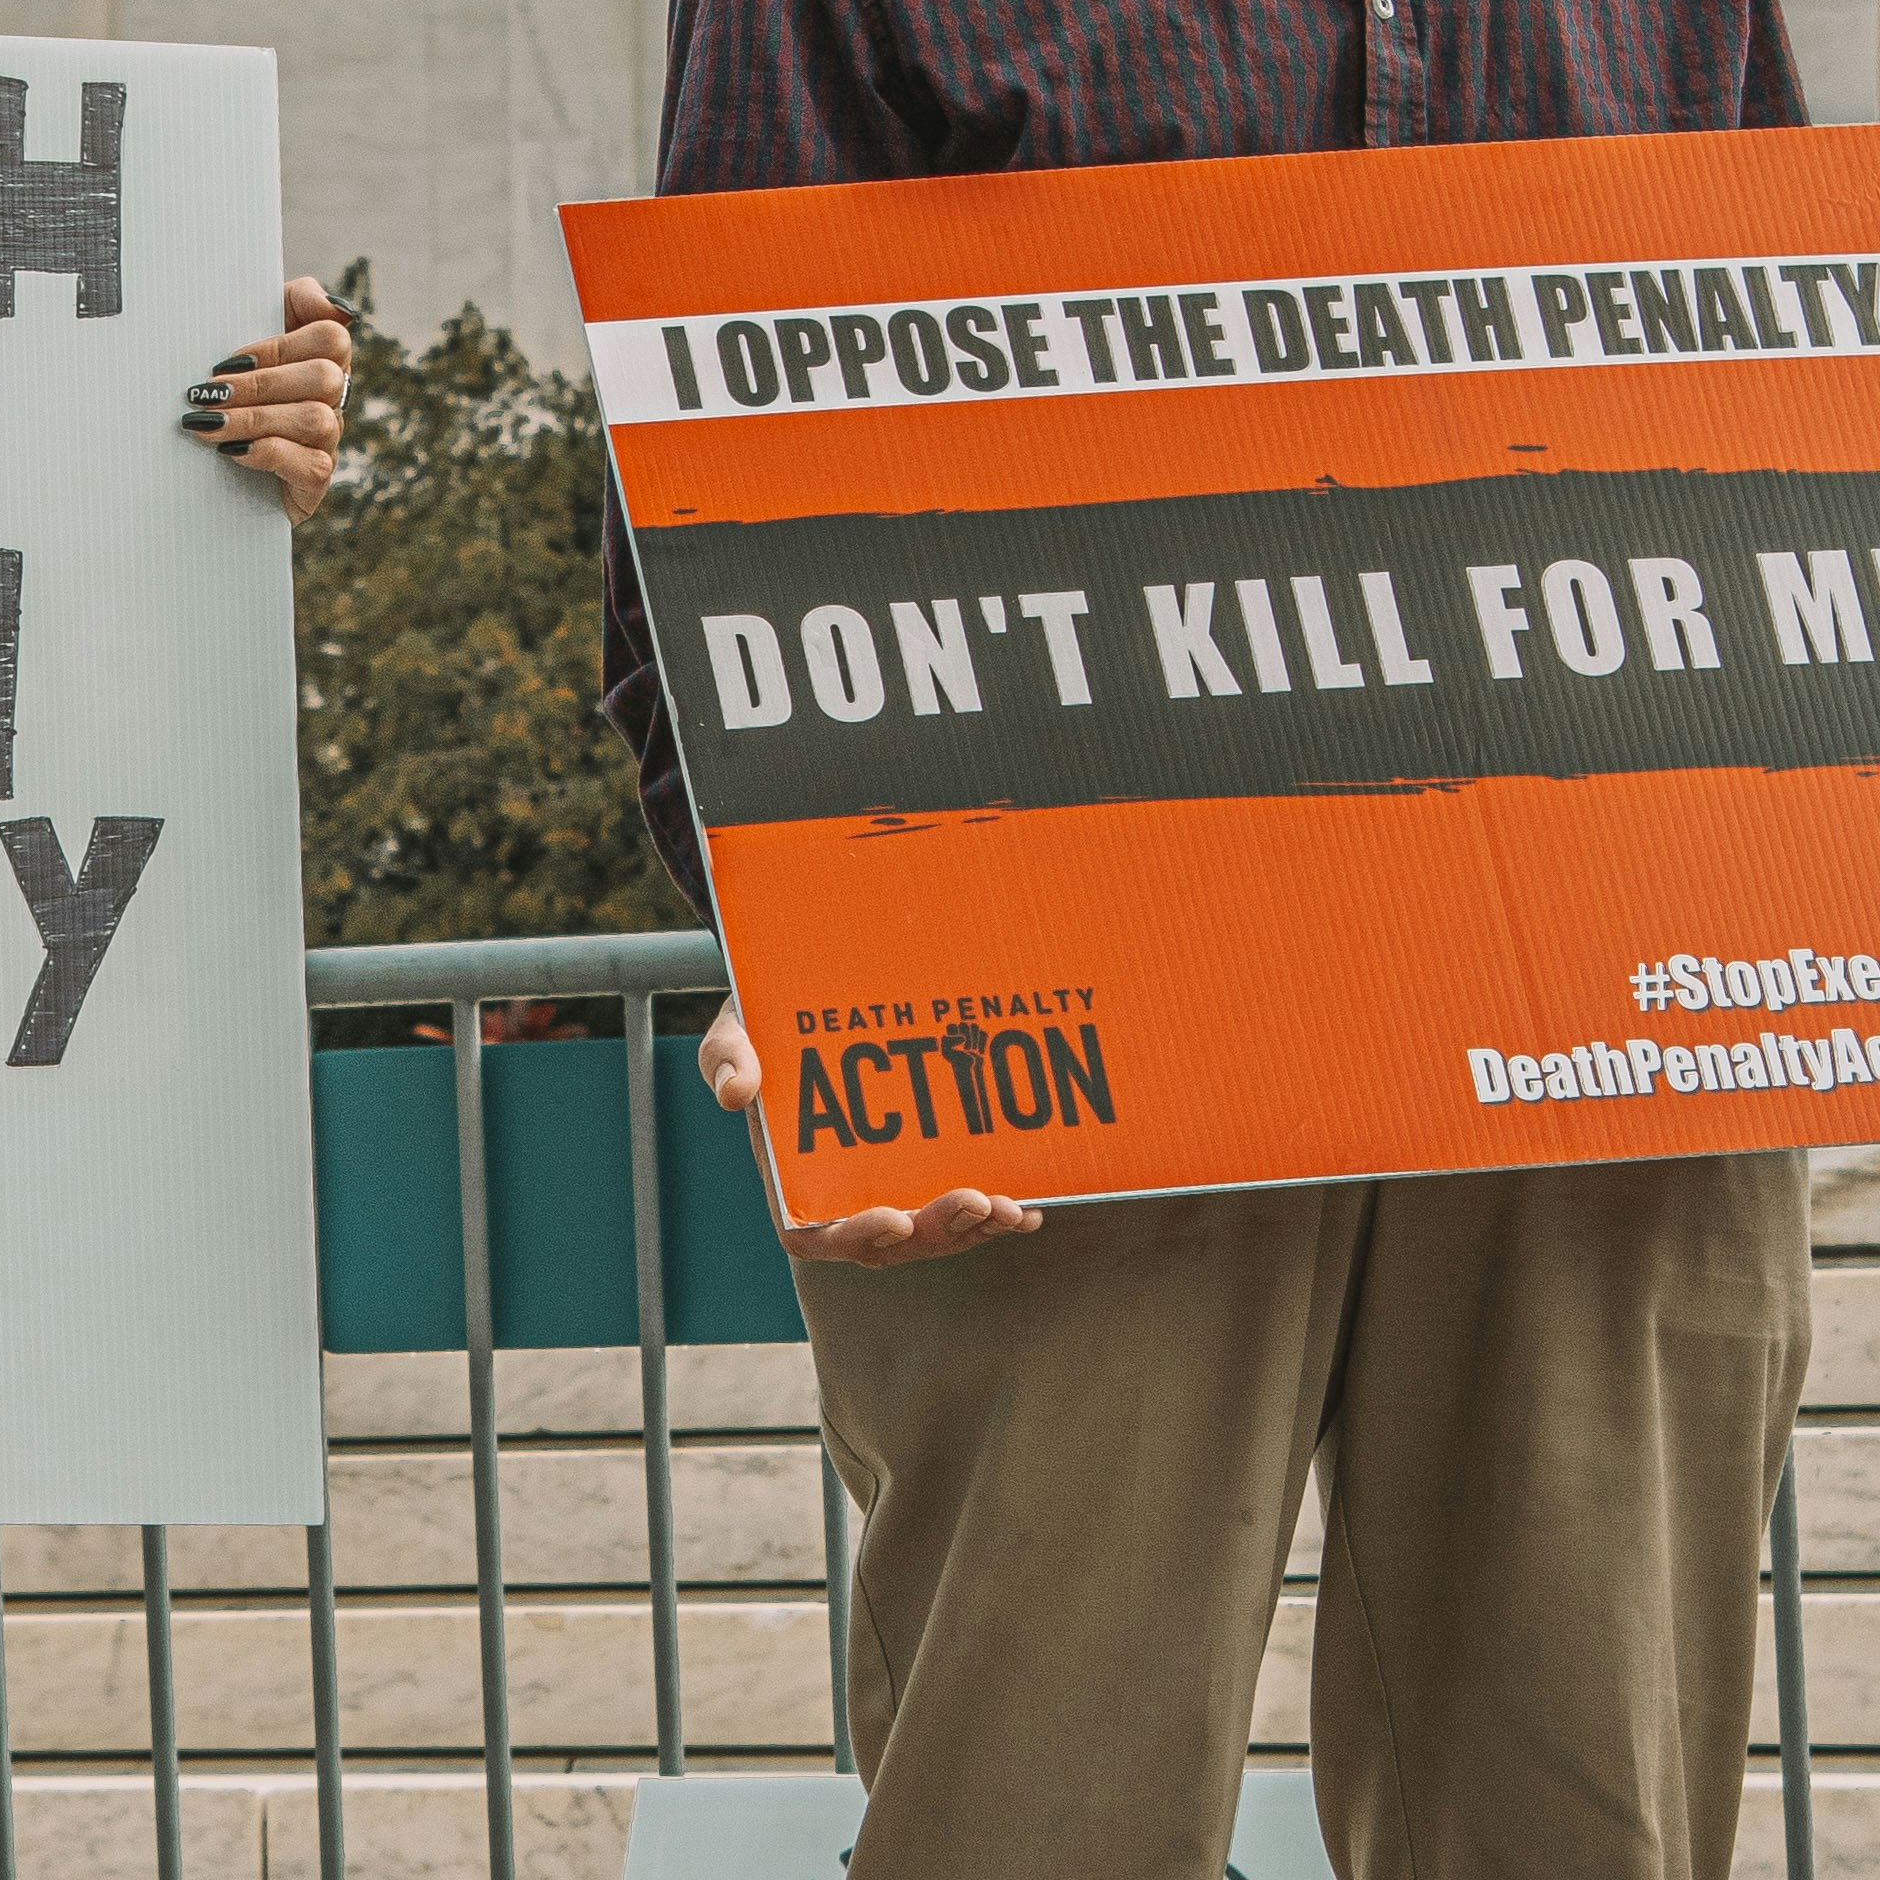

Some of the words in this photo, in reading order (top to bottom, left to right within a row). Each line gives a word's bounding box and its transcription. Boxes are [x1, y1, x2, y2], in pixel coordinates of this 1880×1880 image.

[663, 324, 703, 411] I
[721, 301, 1063, 409] OPPOSE
[1065, 283, 1236, 384] THE
[1240, 275, 1525, 375] DEATH
[1529, 261, 1880, 359] PENALTY
[700, 588, 1094, 731] DON'T
[1141, 569, 1435, 699] KILL
[1465, 557, 1721, 680] FOR
[1755, 547, 1880, 666] M
[796, 1002, 915, 1034] DEATH
[931, 987, 1094, 1022] PENALTY
[1629, 947, 1880, 1013] #StopExe
